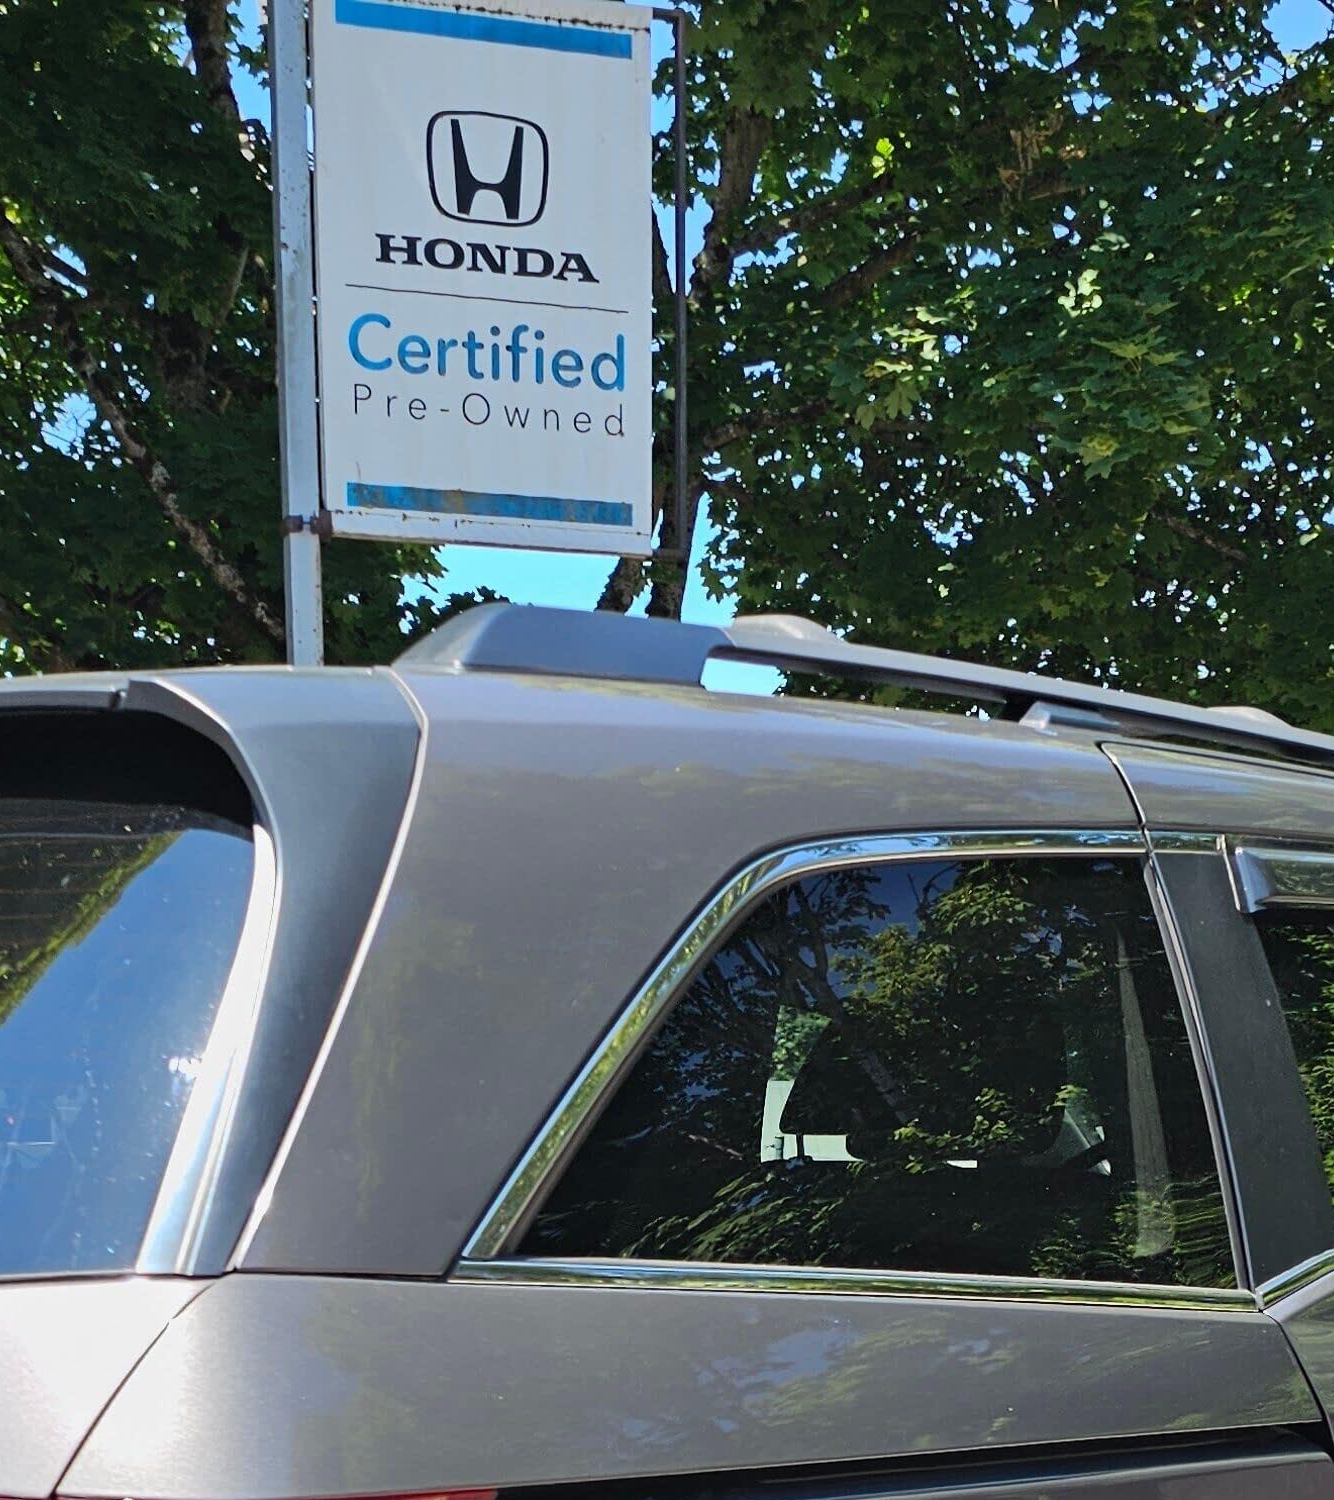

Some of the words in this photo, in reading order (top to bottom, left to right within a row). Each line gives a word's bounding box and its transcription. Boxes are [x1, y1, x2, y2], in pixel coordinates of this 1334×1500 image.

[375, 233, 599, 284] HONDA
[347, 312, 625, 391] Certified
[353, 383, 625, 437] Pre-Owned
